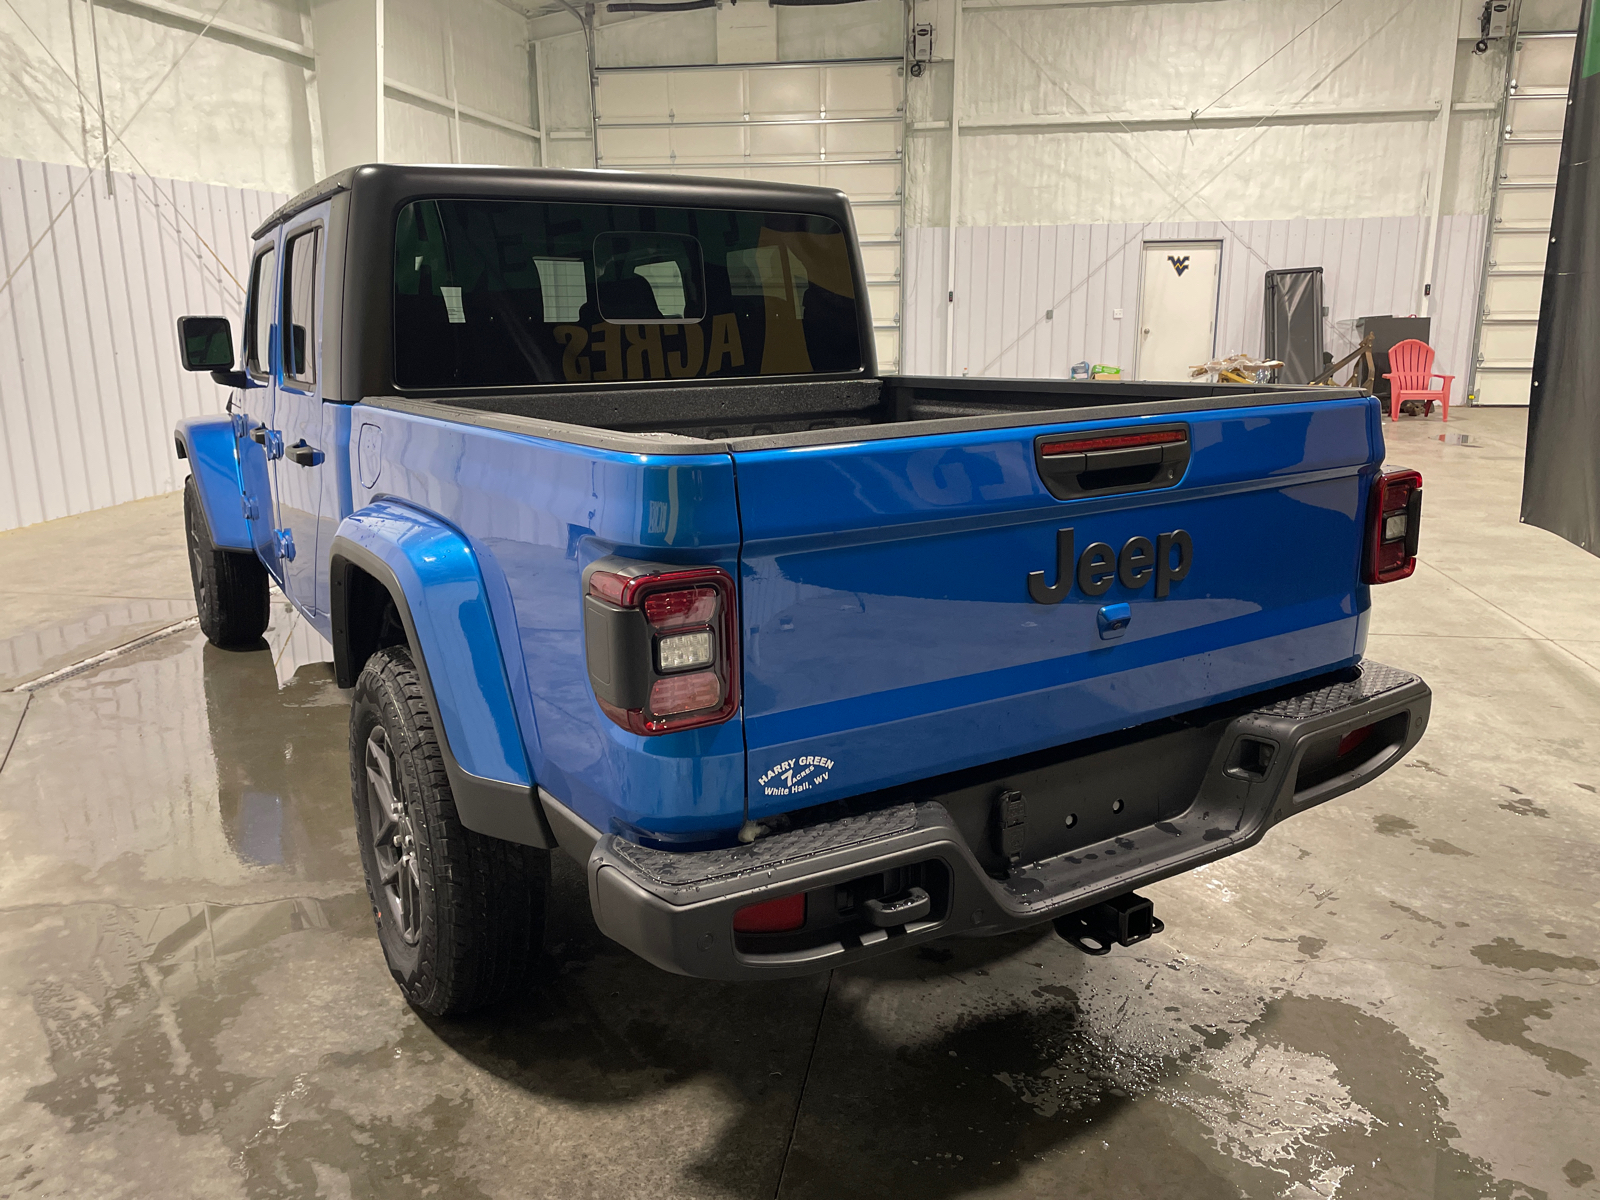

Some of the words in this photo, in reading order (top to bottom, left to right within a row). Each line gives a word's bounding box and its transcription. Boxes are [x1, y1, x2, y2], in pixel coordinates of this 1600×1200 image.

[1028, 527, 1193, 605] Jeep
[758, 758, 796, 786] HARRY
[798, 756, 834, 770] GREEN
[764, 787, 789, 796] White
[791, 781, 812, 794] Hall,
[813, 771, 829, 785] WV
[781, 769, 793, 787] 7
[792, 765, 815, 784] ACRES
